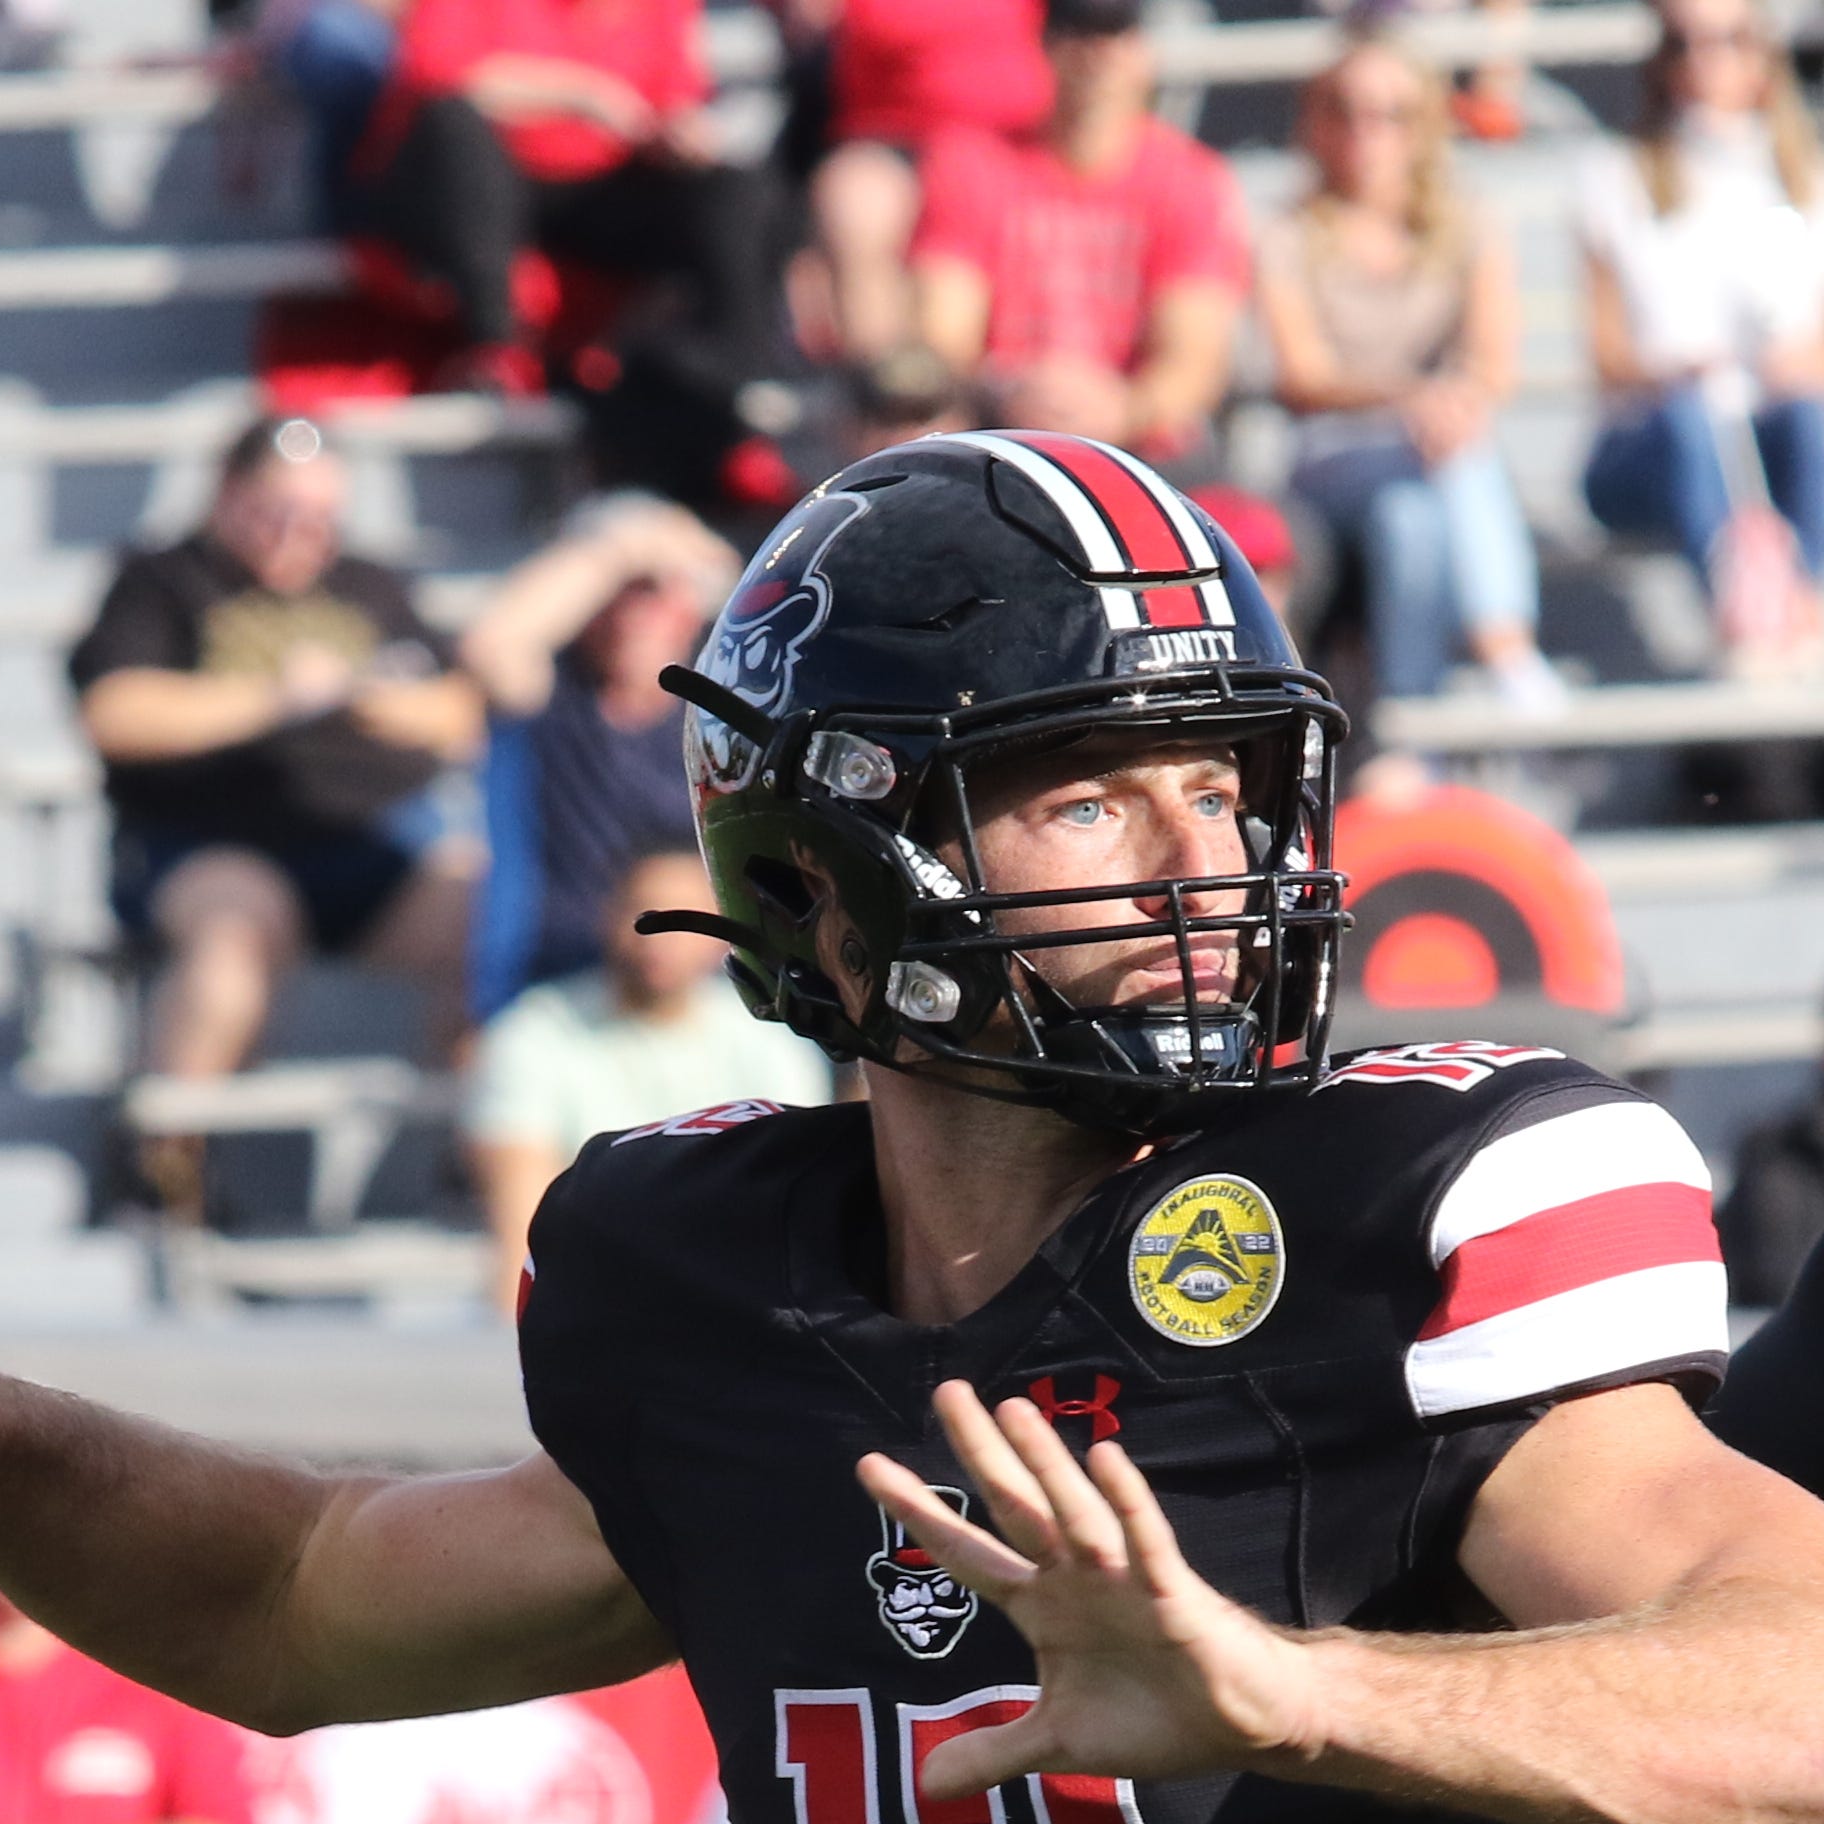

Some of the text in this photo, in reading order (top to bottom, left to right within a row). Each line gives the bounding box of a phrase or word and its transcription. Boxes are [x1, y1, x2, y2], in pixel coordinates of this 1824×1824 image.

[1148, 630, 1237, 662] UNITY
[1162, 1184, 1259, 1219] INAUGURAL
[1243, 1235, 1271, 1250] 22
[1138, 1266, 1272, 1336] FOOTBALL SEASON
